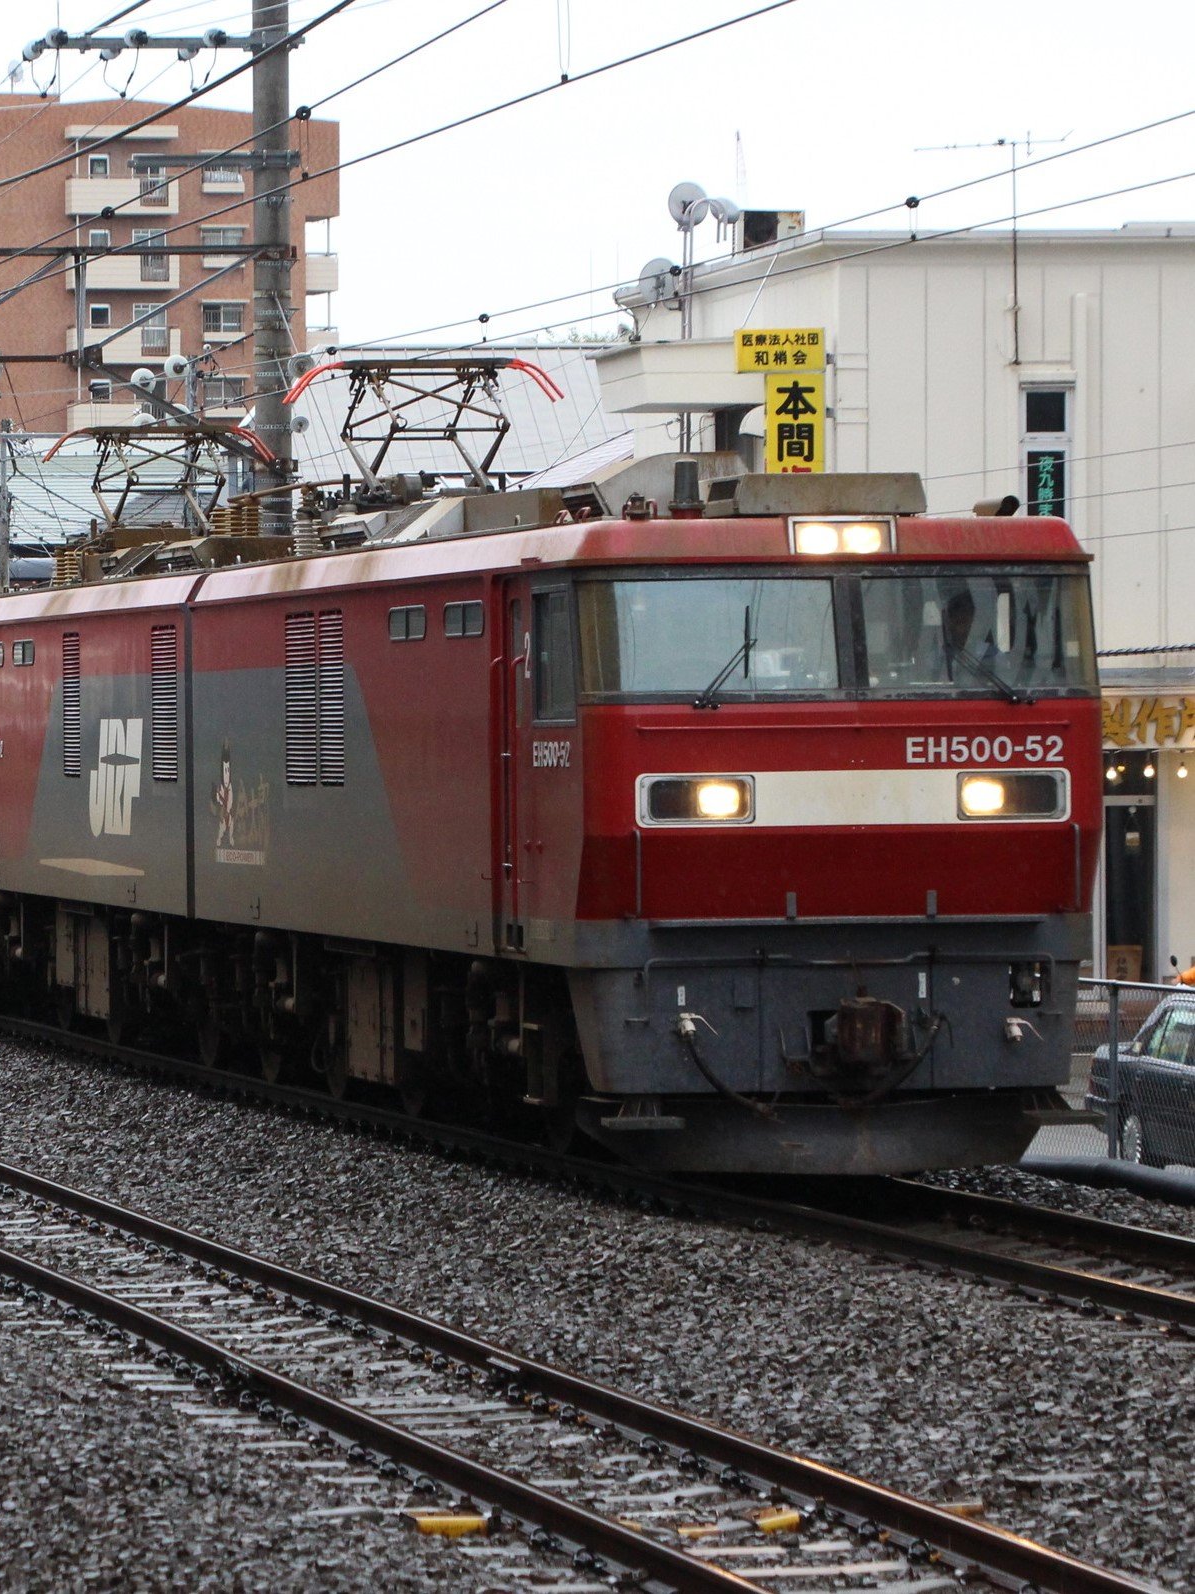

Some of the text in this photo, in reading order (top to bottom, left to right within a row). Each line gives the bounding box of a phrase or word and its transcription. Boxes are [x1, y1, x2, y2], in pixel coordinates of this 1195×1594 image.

[741, 332, 819, 347] 医療法人社団
[775, 380, 817, 473] 本間
[524, 632, 531, 679] 2
[533, 741, 571, 767] EH500-52
[906, 735, 1064, 764] EH500-52
